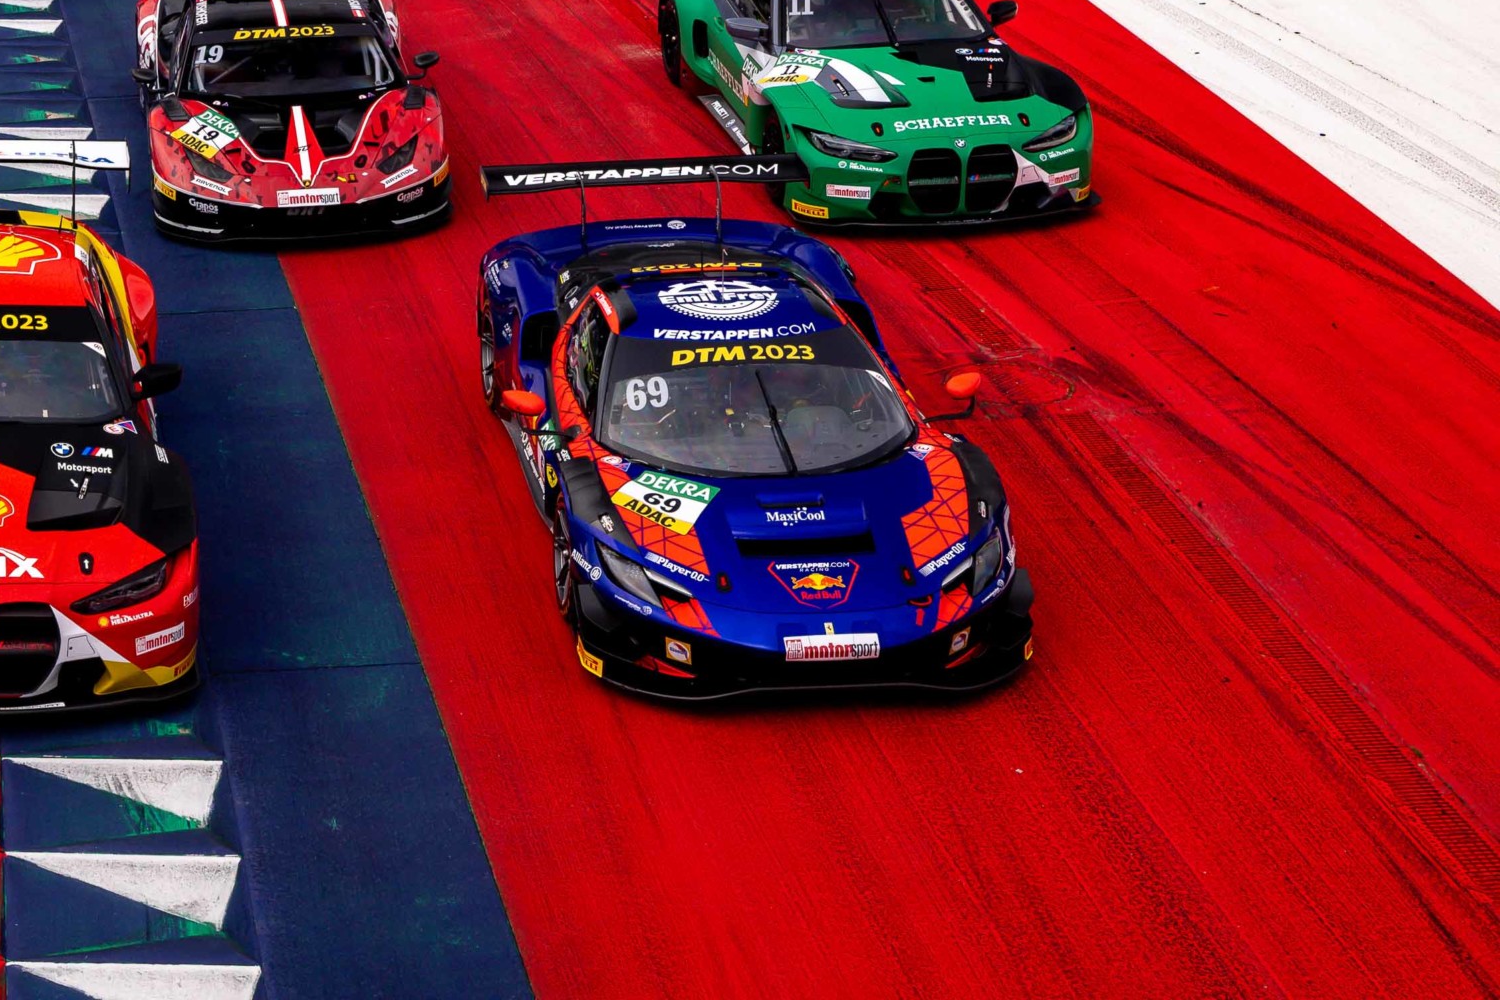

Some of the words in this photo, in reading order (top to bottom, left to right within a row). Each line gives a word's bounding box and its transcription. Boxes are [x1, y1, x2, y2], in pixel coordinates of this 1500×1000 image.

[233, 28, 285, 40] DTM
[289, 26, 335, 37] 2023
[195, 45, 223, 64] 19
[778, 53, 826, 67] DEKRA
[765, 74, 799, 83] ADAC
[199, 111, 239, 138] DEKRA
[894, 115, 1012, 132] SCHAEFFLER
[191, 124, 219, 142] 19
[179, 133, 209, 154] ADAC
[503, 163, 779, 187] VERSTAPPEN.COM
[662, 289, 715, 304] Emil
[723, 292, 777, 301] Frey
[653, 322, 816, 340] VERSTAPPEN.COM
[671, 346, 745, 366] DTM
[748, 344, 816, 361] 2023
[625, 377, 670, 412] 69
[57, 462, 112, 474] Motorsport
[637, 473, 711, 501] DEKRA
[643, 492, 682, 513] 69
[624, 499, 676, 529] ADAC
[766, 509, 825, 522] MaxiCool
[775, 562, 850, 570] VERSTAPPEN.COM
[801, 590, 821, 600] Red
[823, 590, 841, 599] Bull
[804, 641, 878, 659] motorsport
